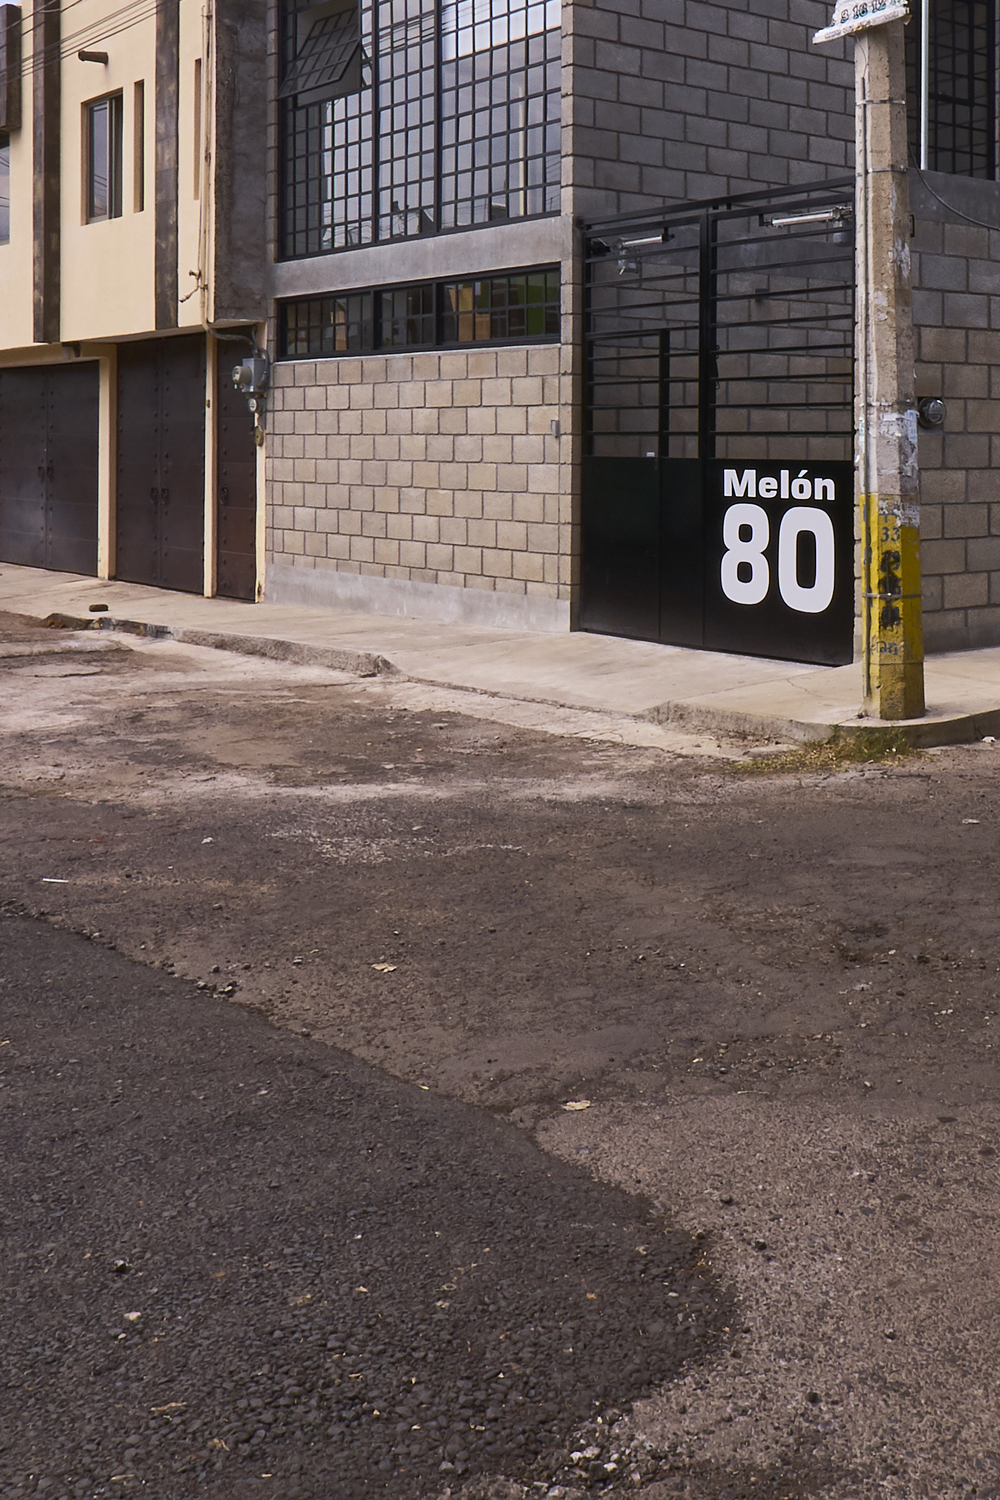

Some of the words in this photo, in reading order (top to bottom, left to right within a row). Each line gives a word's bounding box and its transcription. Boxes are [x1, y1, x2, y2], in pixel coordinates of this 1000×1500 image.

[723, 468, 836, 501] Melón
[880, 527, 901, 543] 33
[720, 503, 835, 614] 80
